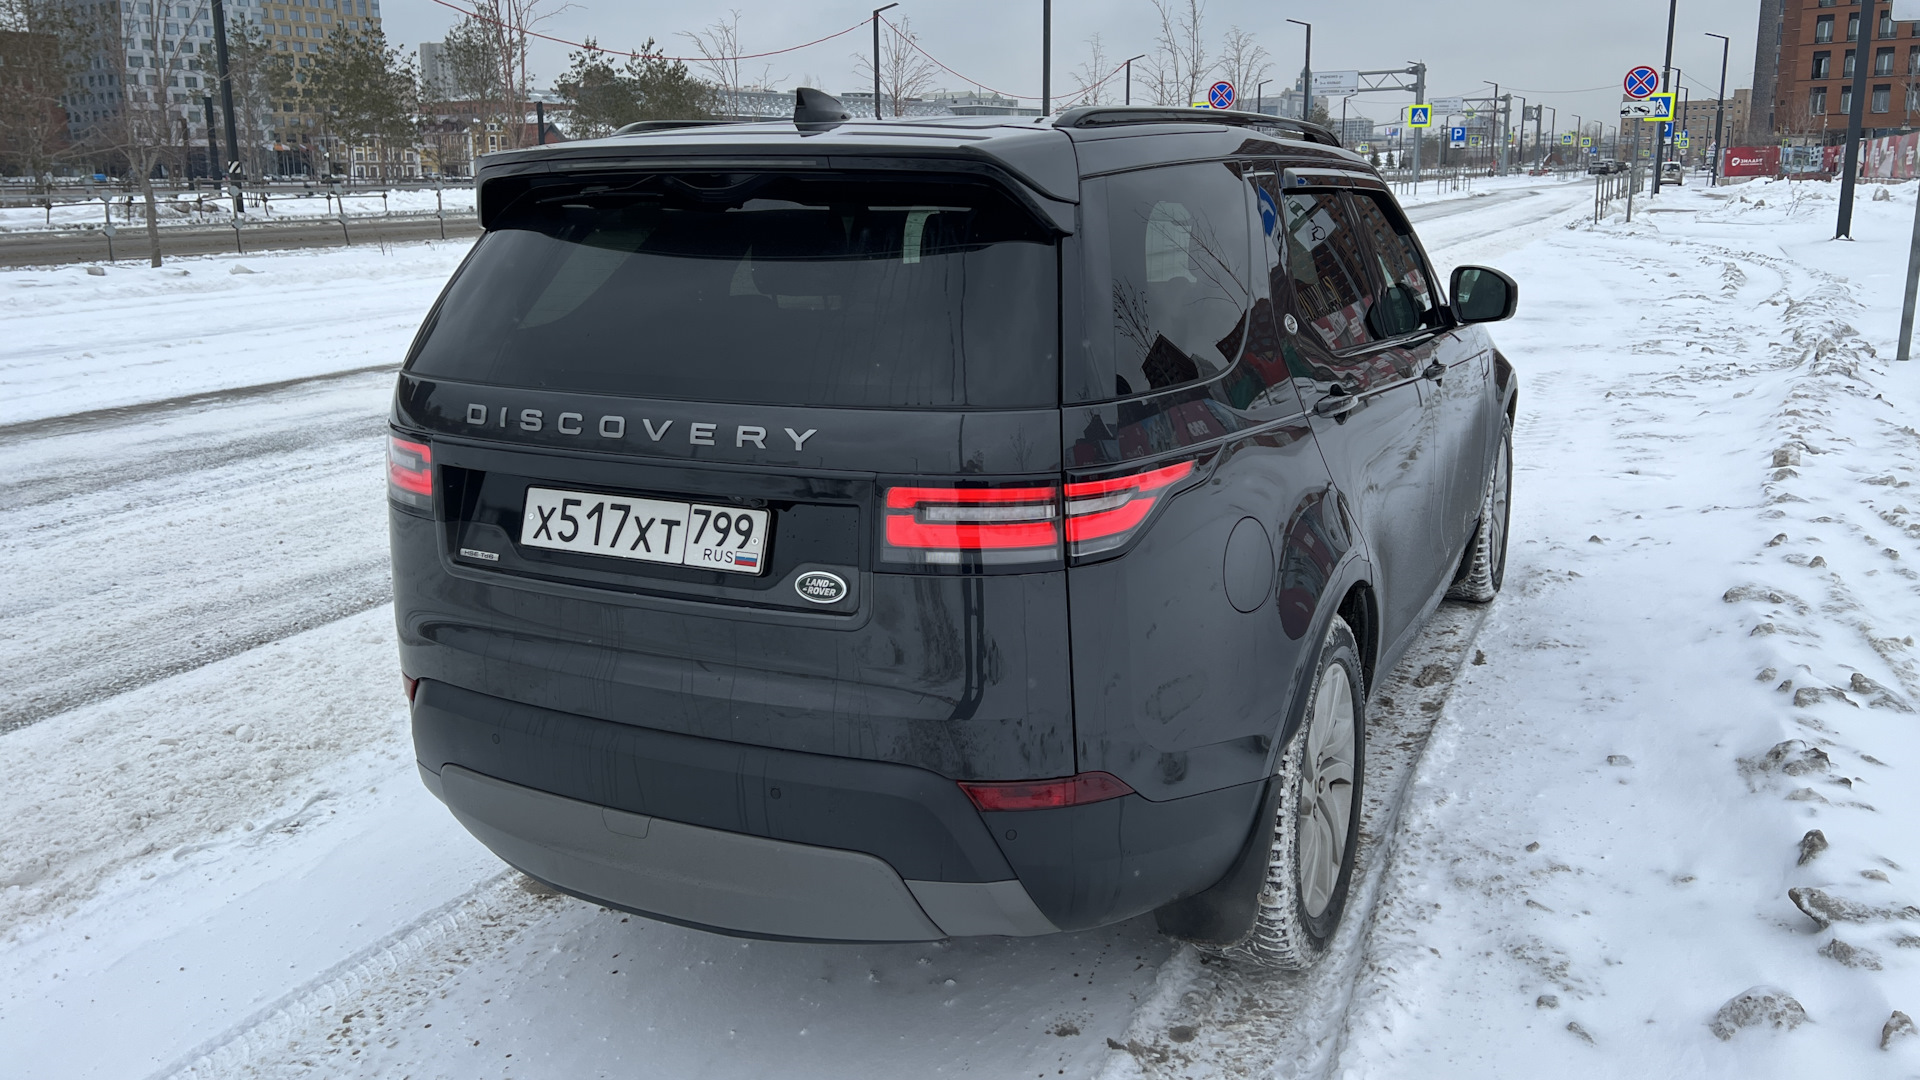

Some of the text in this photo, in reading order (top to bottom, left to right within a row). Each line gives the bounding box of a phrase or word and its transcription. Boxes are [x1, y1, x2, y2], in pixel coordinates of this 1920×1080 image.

[1453, 128, 1463, 140] P
[466, 403, 818, 451] DISCOVERY
[693, 509, 754, 549] 799
[703, 548, 734, 564] RUS
[805, 578, 829, 588] LAND
[806, 586, 836, 597] ROVER
